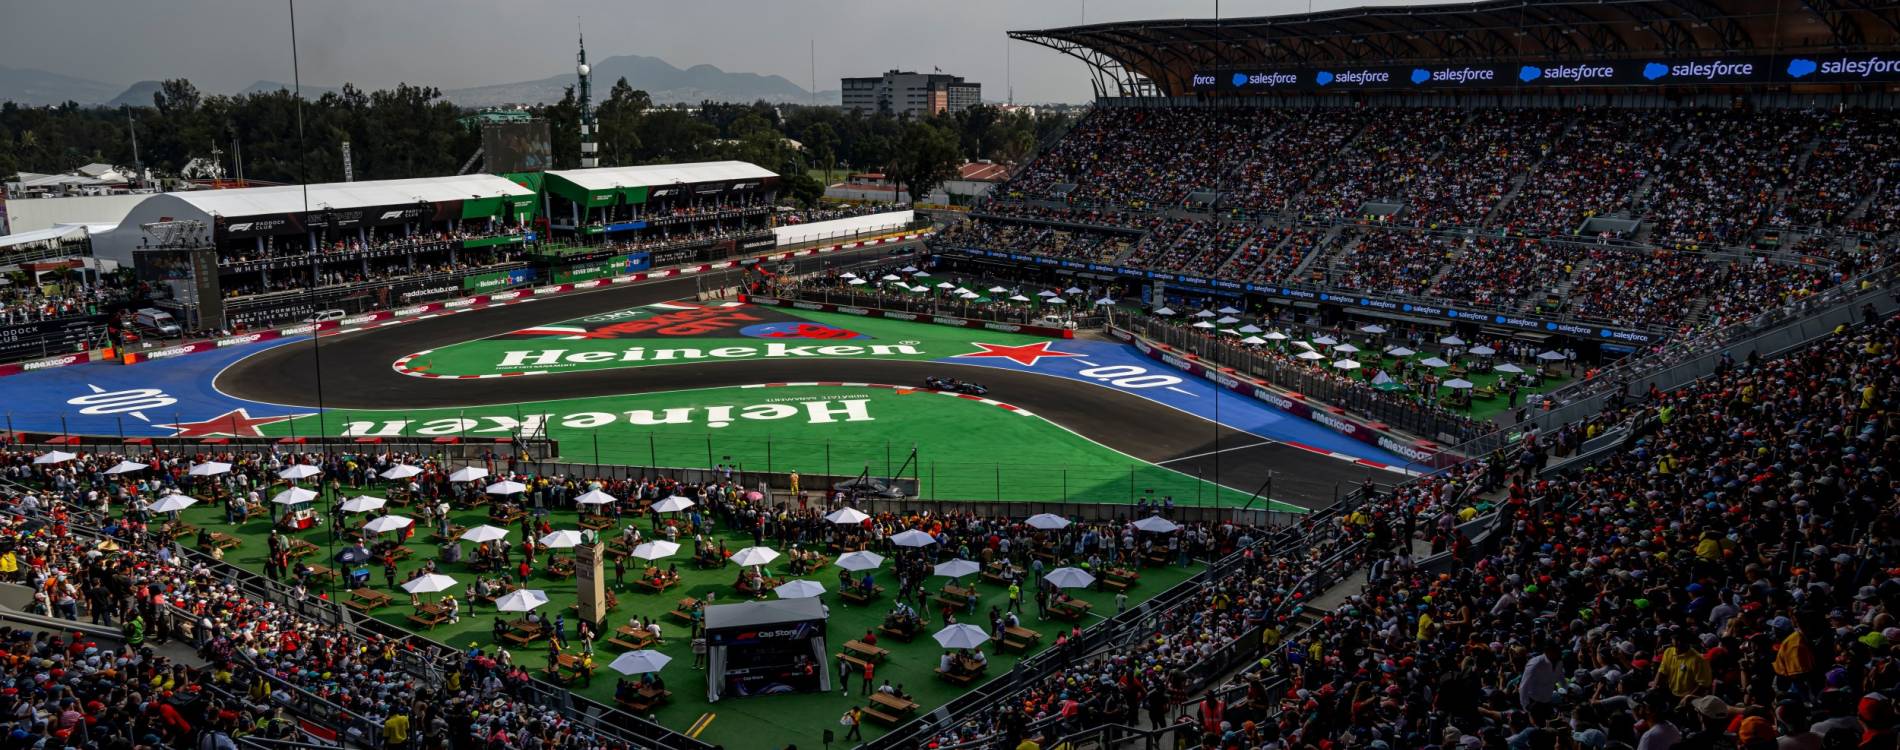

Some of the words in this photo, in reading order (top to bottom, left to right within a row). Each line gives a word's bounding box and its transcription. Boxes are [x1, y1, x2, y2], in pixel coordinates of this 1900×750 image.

[1544, 64, 1614, 82] salesforce
[1671, 60, 1753, 79] salesforce
[1820, 56, 1900, 77] salesforc
[1249, 72, 1297, 87] salesforce
[1335, 69, 1389, 85] salesforce
[1433, 67, 1494, 84] salesforce
[234, 263, 275, 273] WHERE
[283, 255, 355, 268] ADRENALINE
[361, 250, 394, 259] MEETS
[401, 244, 451, 254] ELEGANCE
[1254, 284, 1277, 294] salesforce
[1290, 288, 1314, 298] salesforce
[1329, 294, 1354, 304] salesforce
[1369, 300, 1396, 309] salesforce
[1412, 305, 1441, 315] salesforce
[1458, 310, 1488, 321] salesforce
[1506, 317, 1539, 328] salesforce
[1558, 323, 1592, 335] salesforce
[0, 326, 39, 337] ADDOCK
[1613, 330, 1649, 342] salesforce
[217, 334, 261, 347] #MexicoGP
[148, 345, 195, 359] #MexicoGP
[496, 343, 926, 367] Heineken
[24, 356, 77, 371] #MexicoGP
[1254, 388, 1293, 410] #MexicoGP
[340, 399, 876, 437] Heineken
[1311, 410, 1356, 434] #MexicoGP
[1378, 435, 1432, 462] #MexicoGP
[758, 630, 774, 639] Cap
[775, 628, 798, 637] Store
